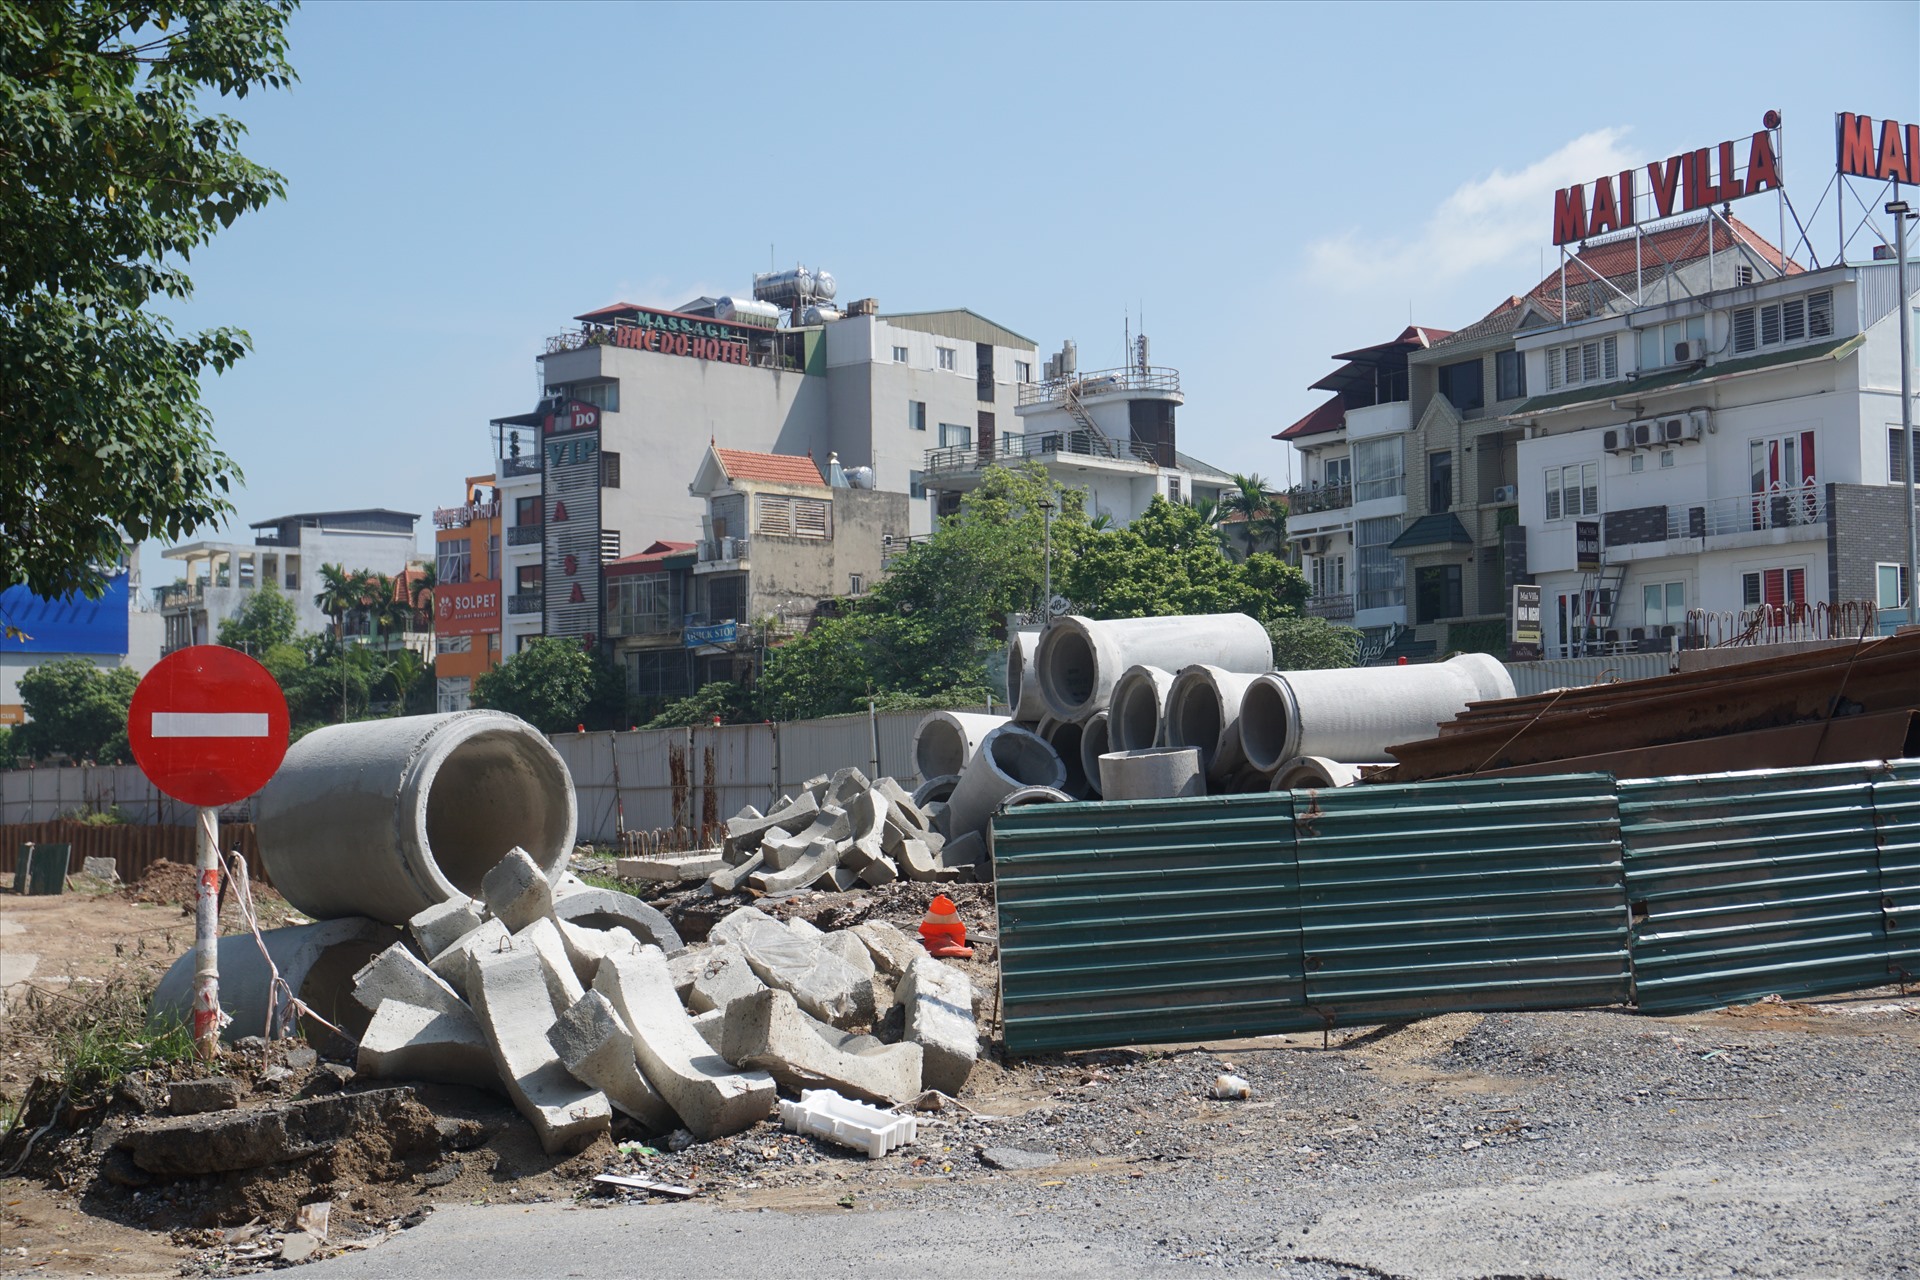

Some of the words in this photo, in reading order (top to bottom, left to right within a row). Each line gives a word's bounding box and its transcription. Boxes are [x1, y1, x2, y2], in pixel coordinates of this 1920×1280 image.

[1838, 111, 1920, 186] MAI
[1552, 169, 1634, 246] MAI
[1647, 129, 1782, 219] VILLA
[636, 311, 731, 340] MASSAGE
[692, 334, 750, 367] HOTEL
[575, 412, 596, 427] DO
[546, 439, 597, 468] VIP
[455, 593, 497, 610] SOLPET
[714, 627, 735, 638] STOP
